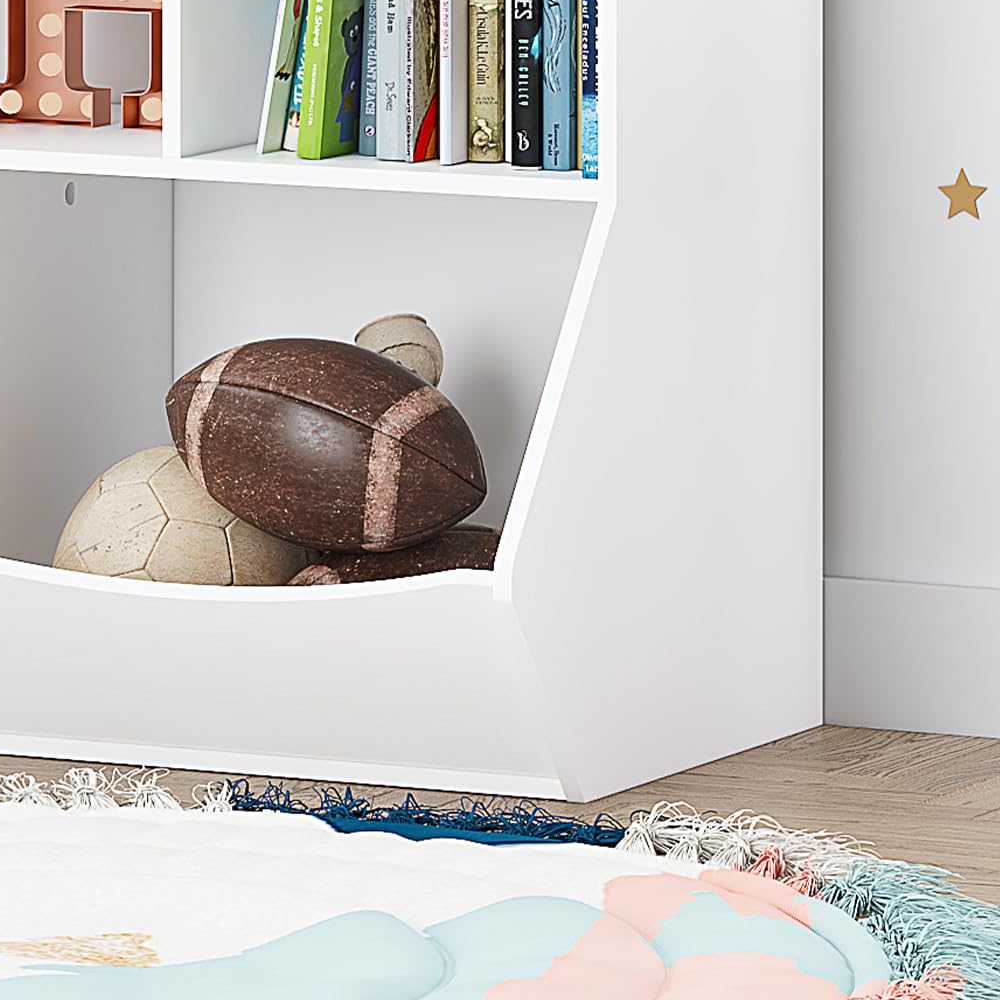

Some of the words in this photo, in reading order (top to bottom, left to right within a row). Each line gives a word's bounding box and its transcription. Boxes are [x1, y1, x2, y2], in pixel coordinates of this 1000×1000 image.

[312, 14, 323, 48] Shapes
[387, 12, 396, 34] Ham
[477, 11, 490, 40] Ursula
[477, 50, 489, 62] Le
[518, 39, 529, 58] BEN
[366, 47, 377, 80] GIANT
[405, 63, 412, 76] by
[477, 63, 490, 85] Guin
[365, 81, 376, 115] PEACH
[518, 66, 529, 106] GALLEY
